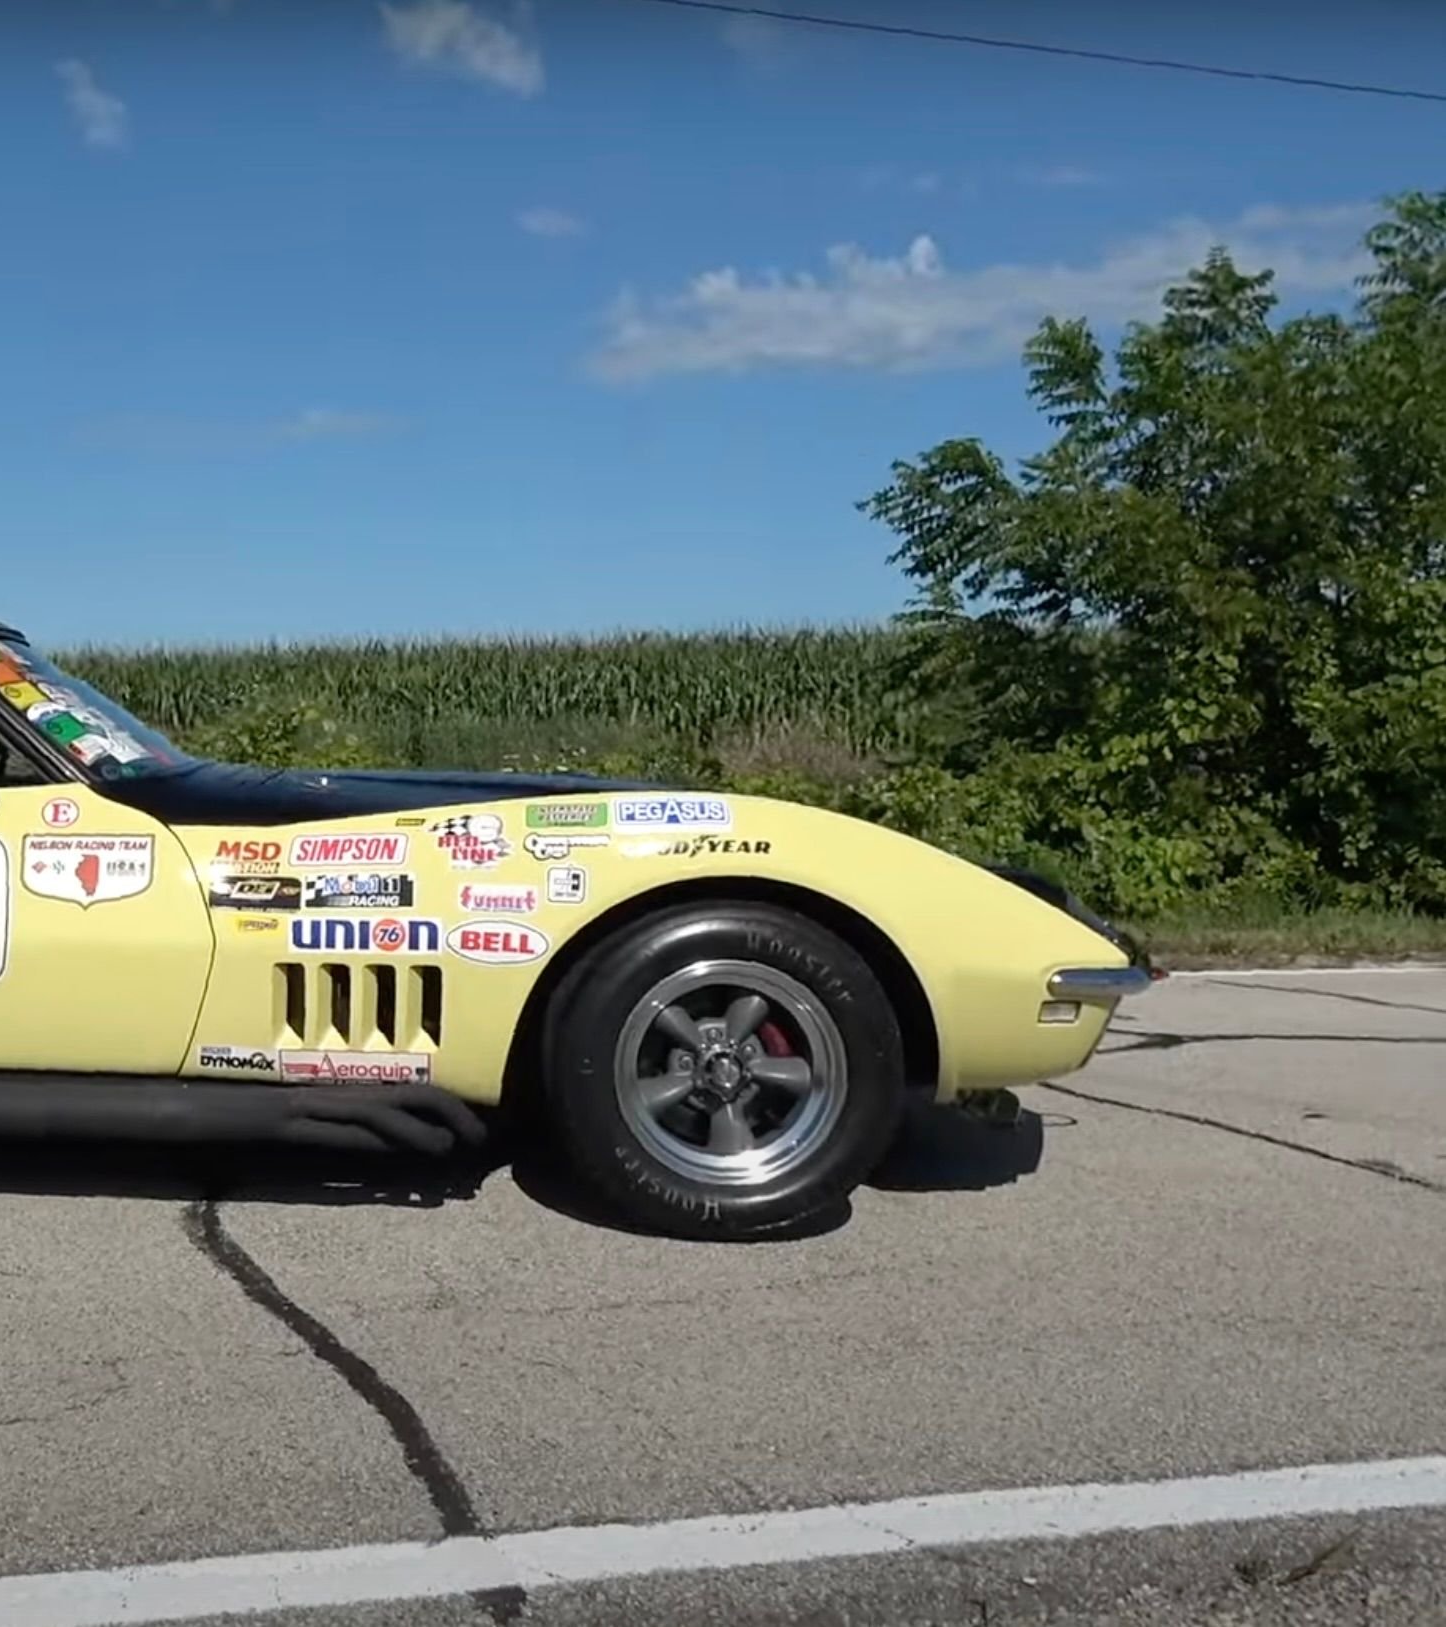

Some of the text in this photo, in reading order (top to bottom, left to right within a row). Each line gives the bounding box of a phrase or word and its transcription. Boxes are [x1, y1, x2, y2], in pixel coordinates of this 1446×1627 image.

[52, 803, 72, 823] E
[621, 799, 724, 823] PEGASUS
[74, 840, 115, 851] RACING
[118, 840, 149, 851] TEAM
[216, 841, 282, 861] MSD
[296, 838, 399, 861] SIMPSON
[349, 895, 400, 907] RACING
[461, 931, 535, 954] BELL
[317, 1053, 413, 1081] Aeroquip
